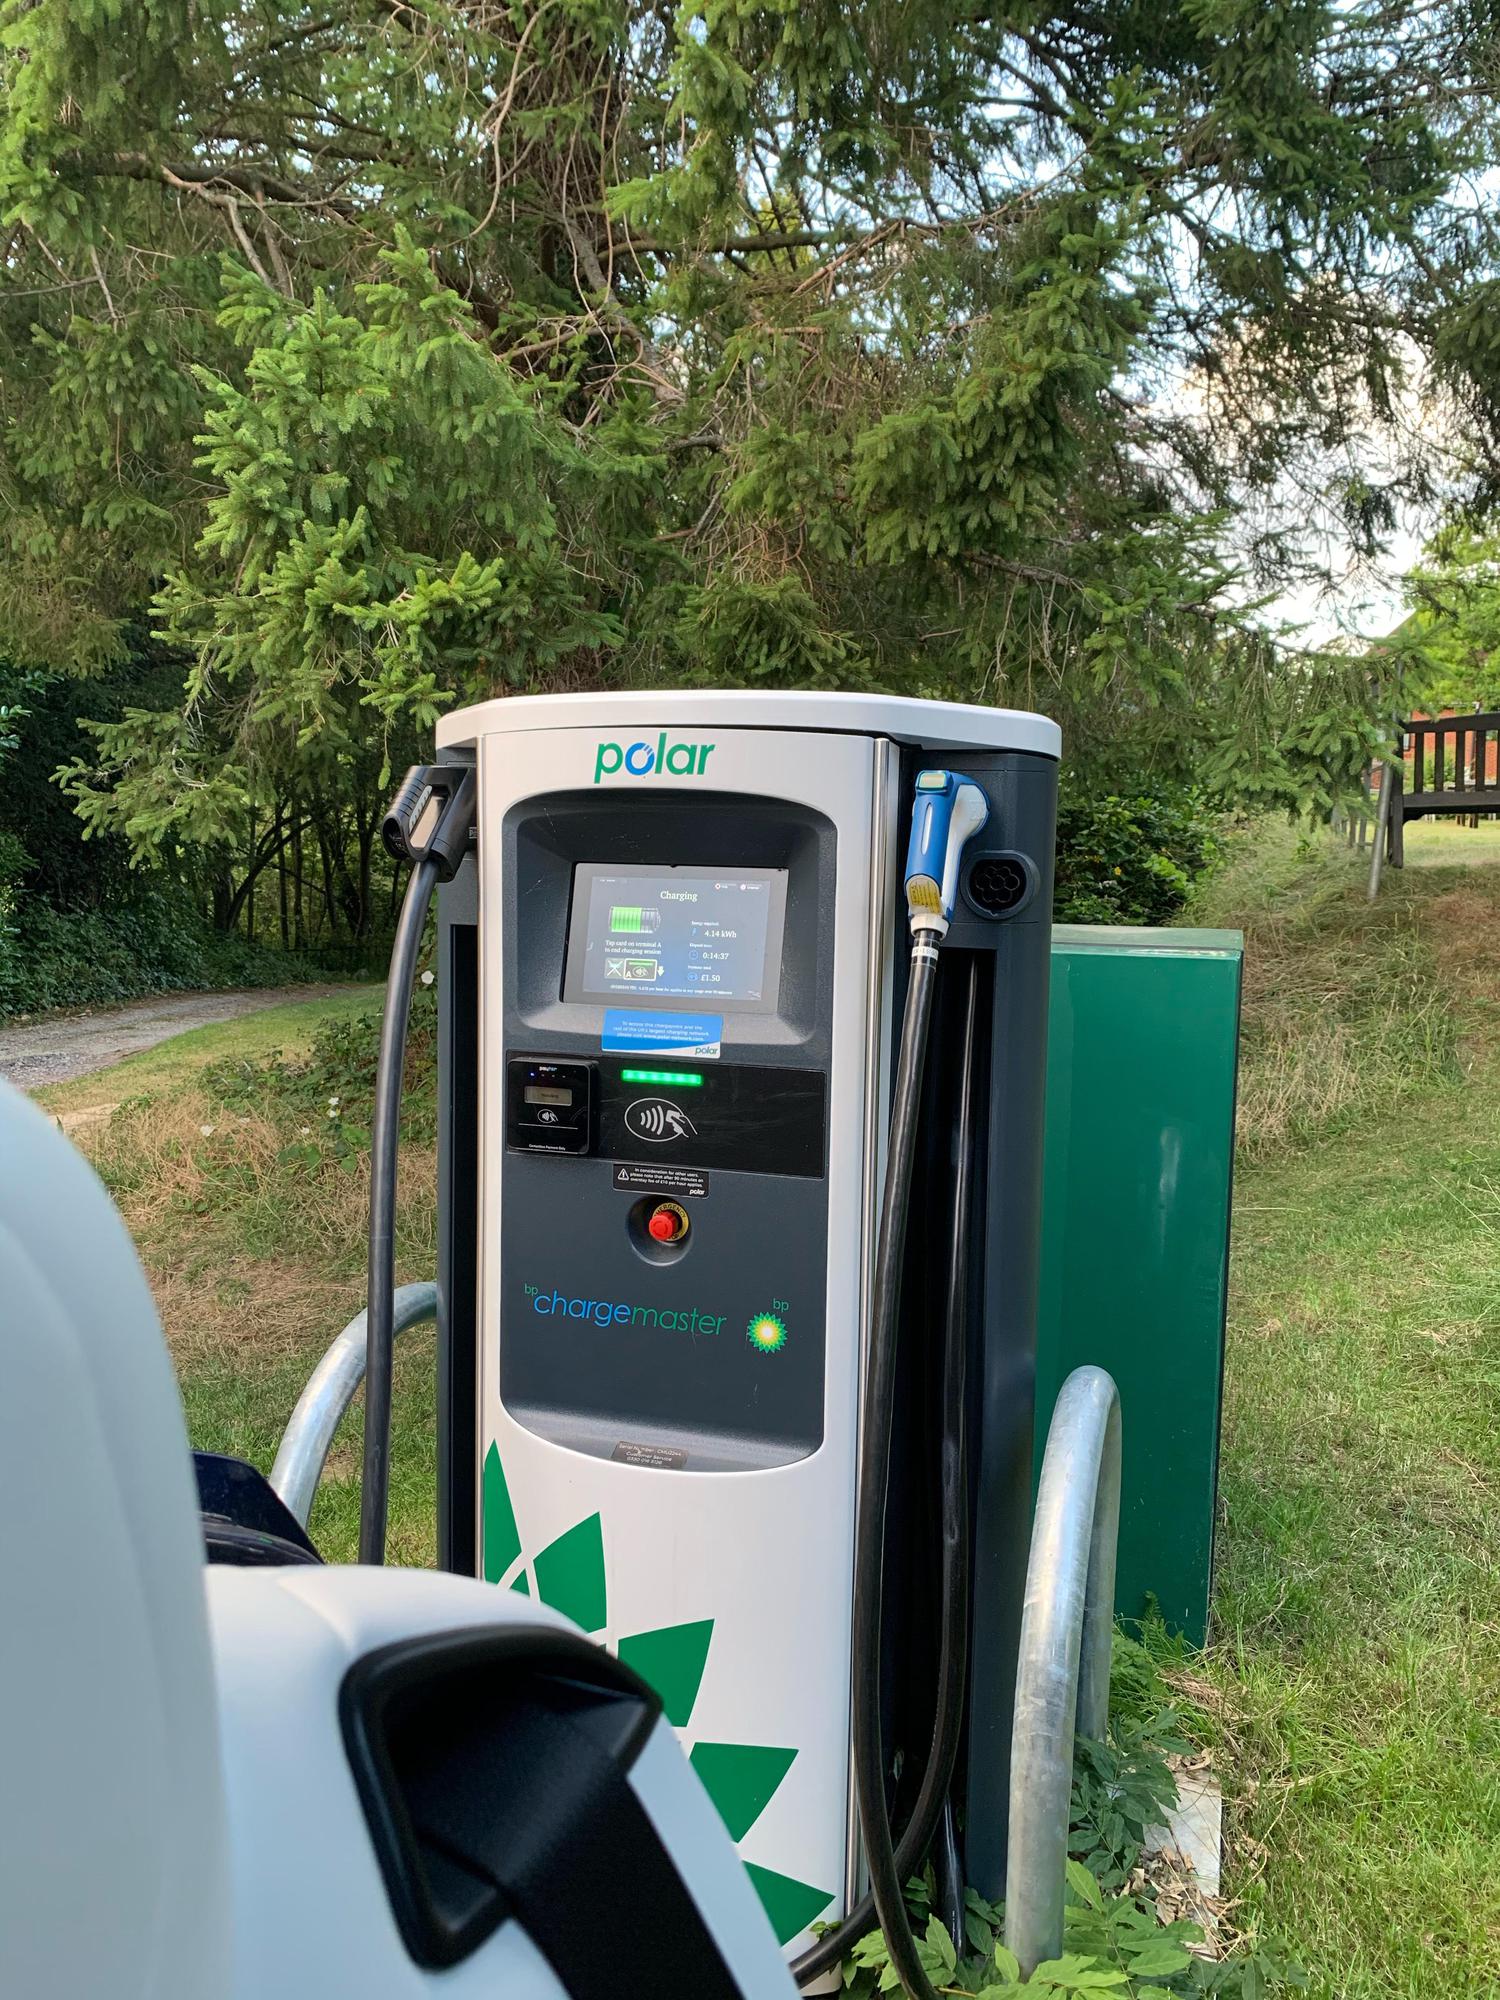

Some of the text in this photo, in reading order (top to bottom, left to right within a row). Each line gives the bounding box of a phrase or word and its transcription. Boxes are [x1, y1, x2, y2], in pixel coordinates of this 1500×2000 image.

[594, 732, 716, 784] polar
[660, 890, 698, 902] Charging
[704, 929, 737, 938] 4.14 kWh
[702, 952, 729, 960] 0:14:37
[701, 974, 721, 982] £1.50
[695, 1046, 719, 1055] polar
[653, 1203, 686, 1218] MERGENCY
[524, 1283, 539, 1296] bp
[773, 1298, 789, 1313] bp
[533, 1290, 727, 1336] chargemaster
